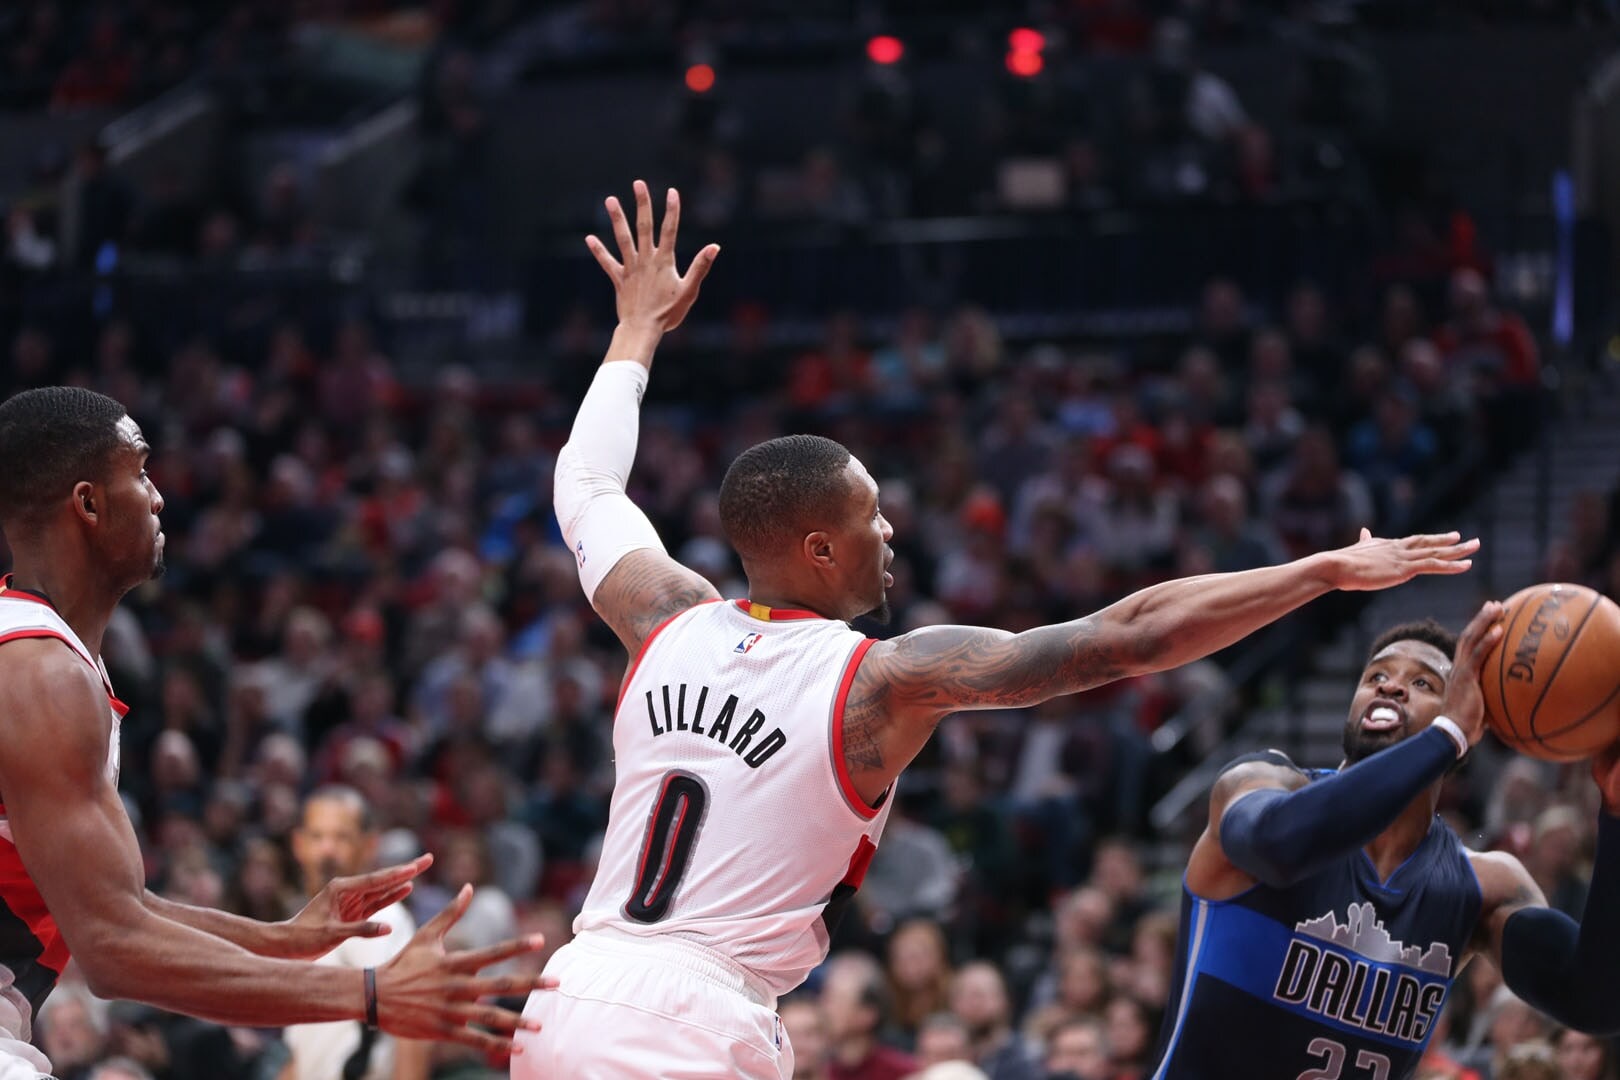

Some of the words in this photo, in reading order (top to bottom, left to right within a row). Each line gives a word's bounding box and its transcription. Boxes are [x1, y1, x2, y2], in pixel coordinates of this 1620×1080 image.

[646, 684, 786, 768] LILLARD
[620, 769, 711, 925] 0
[1273, 938, 1446, 1043] DALLAS
